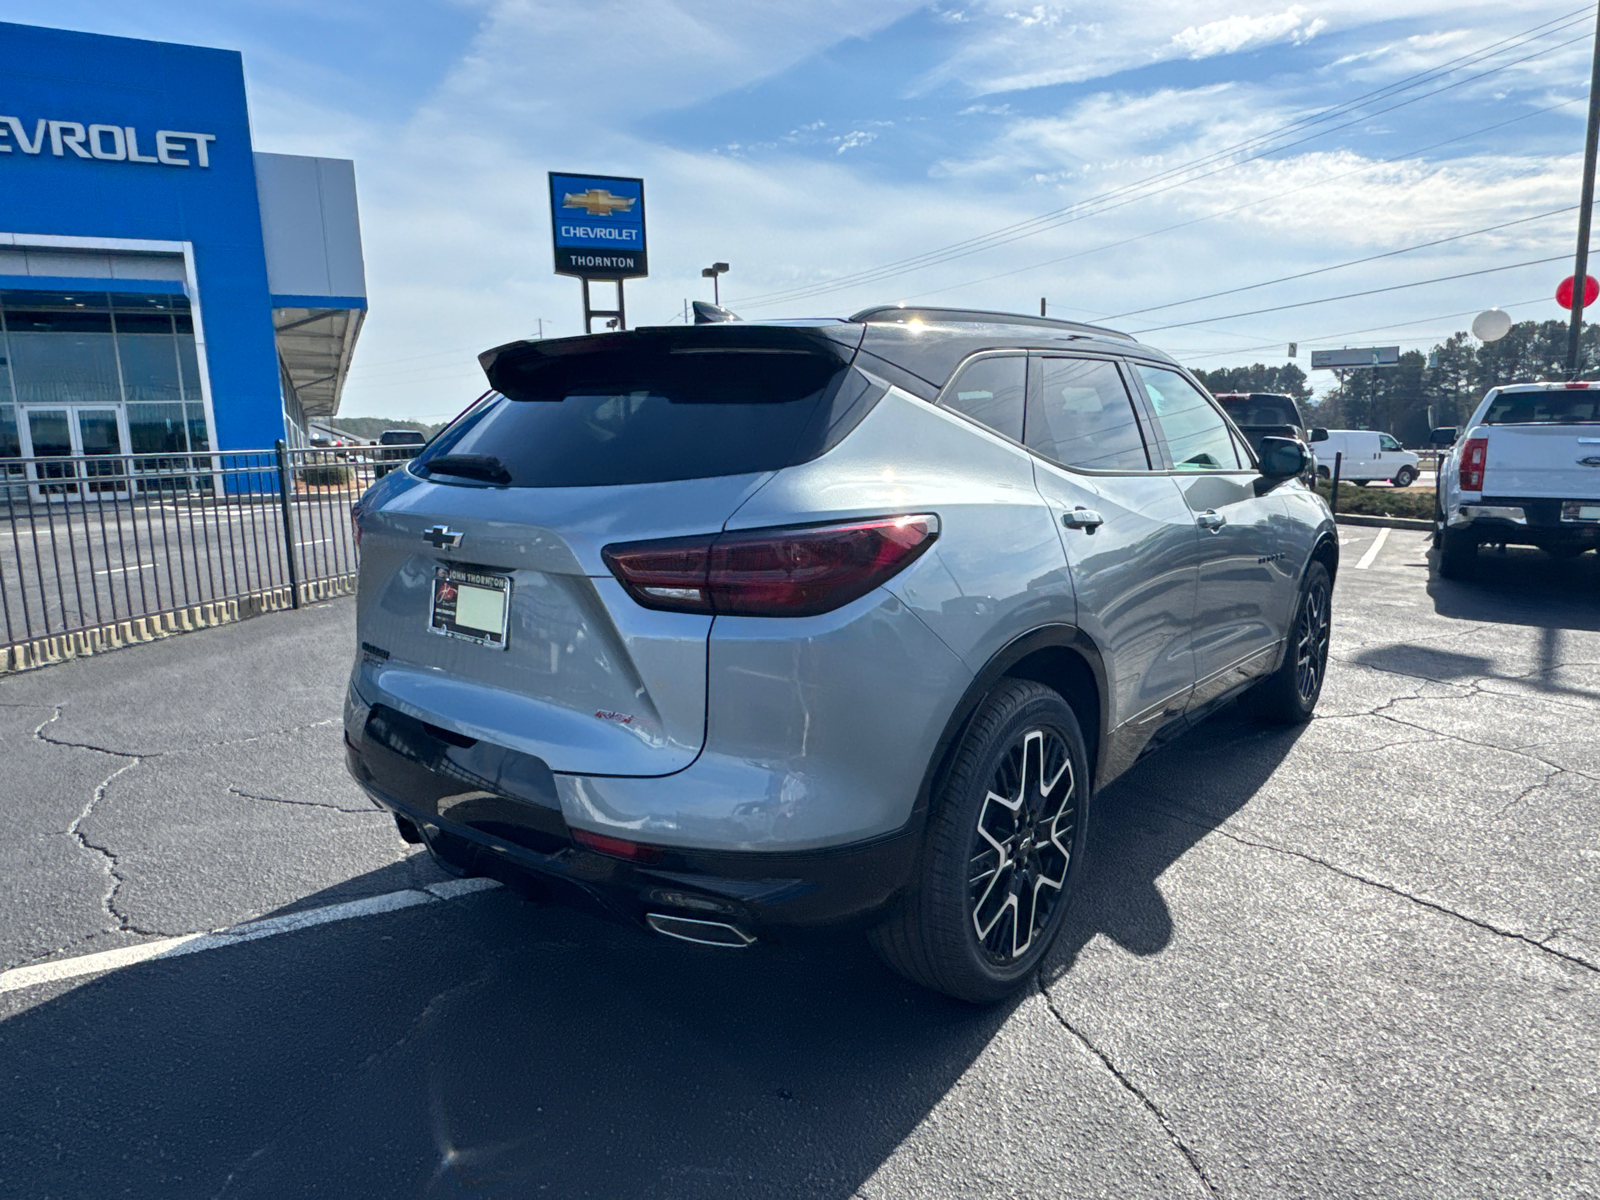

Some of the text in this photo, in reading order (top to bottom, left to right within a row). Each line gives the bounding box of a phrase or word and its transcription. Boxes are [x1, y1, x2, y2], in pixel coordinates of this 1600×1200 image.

[561, 225, 638, 241] CHEVROLET
[570, 255, 634, 268] THORNTON
[449, 570, 504, 587] JOHN THORNTON
